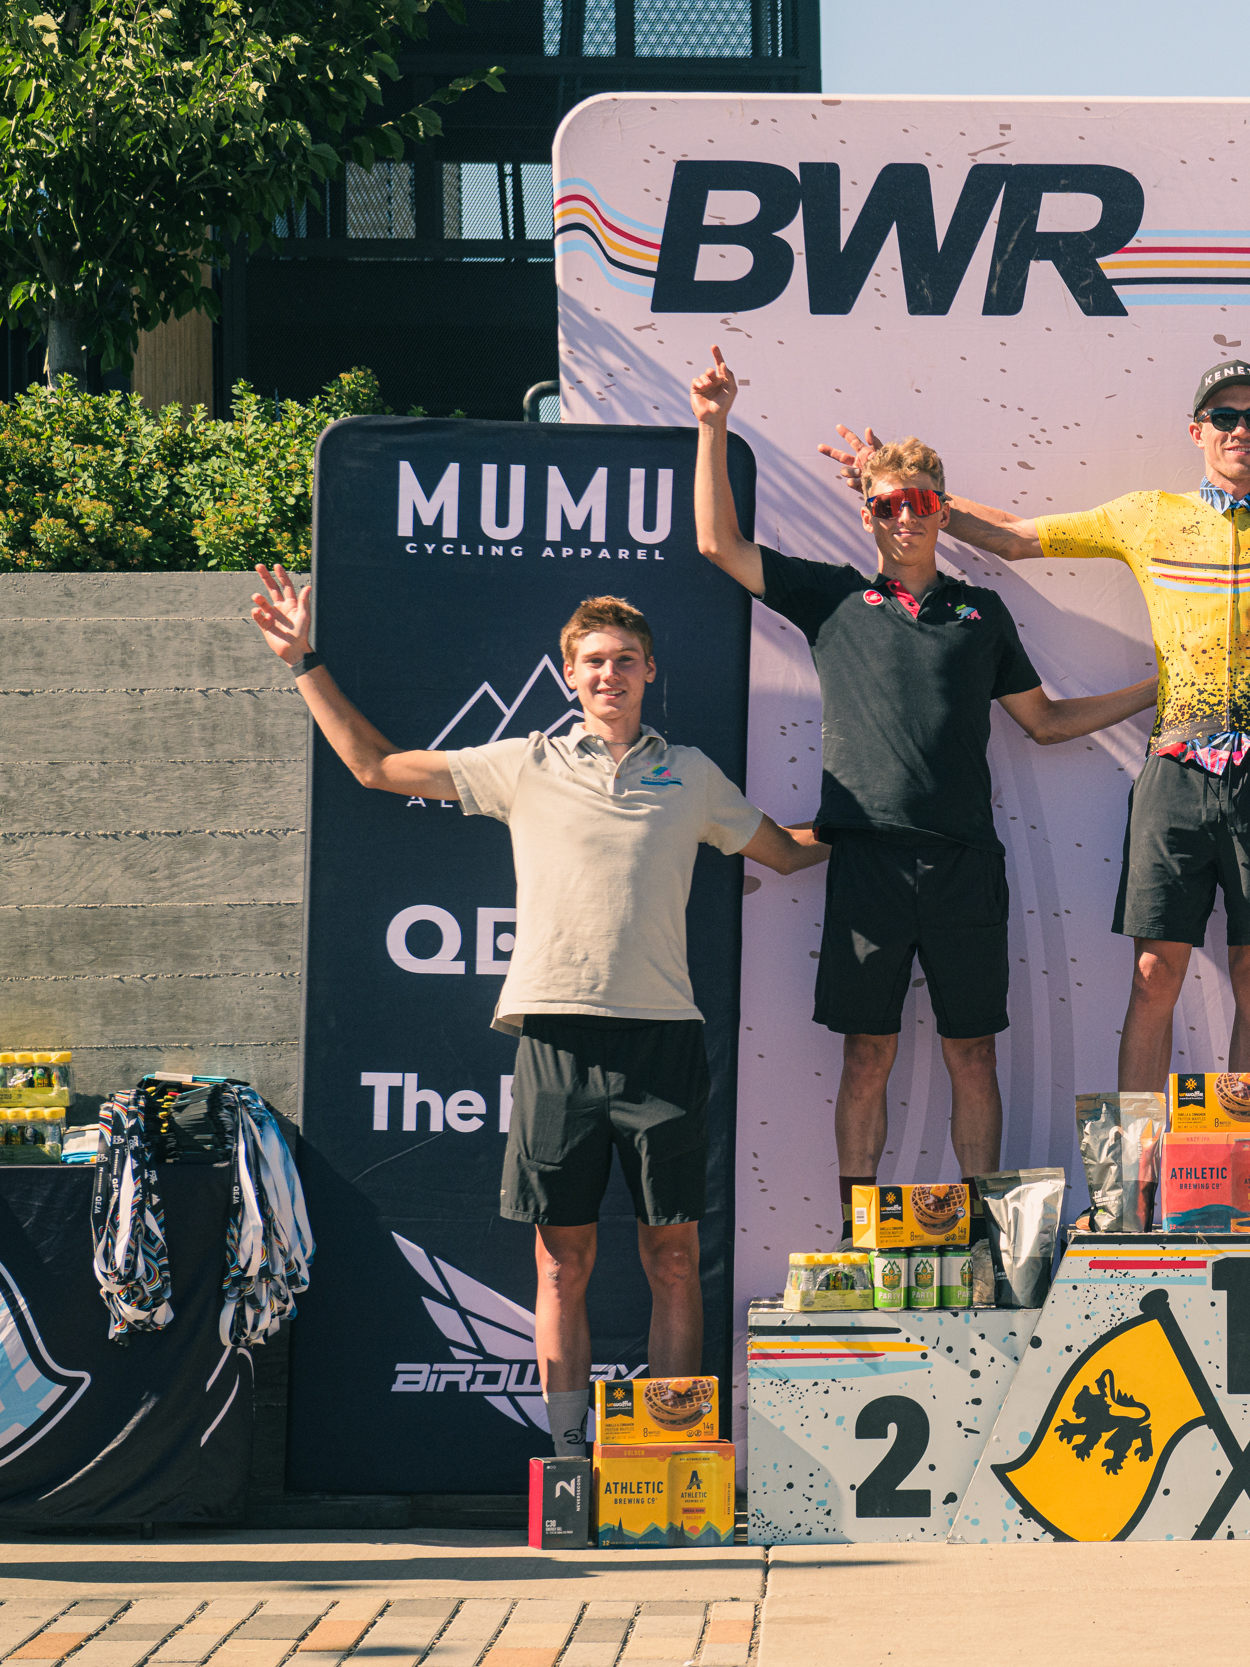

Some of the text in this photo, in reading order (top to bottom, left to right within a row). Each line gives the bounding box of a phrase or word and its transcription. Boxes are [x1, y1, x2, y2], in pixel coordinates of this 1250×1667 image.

[651, 160, 1145, 316] BWR
[397, 460, 674, 544] MUMU
[405, 541, 665, 561] CYCLING APPAREL
[360, 1072, 486, 1133] The
[1170, 1167, 1227, 1180] ATHLETIC
[604, 1481, 664, 1494] ATHLETIC
[855, 1395, 931, 1519] 2
